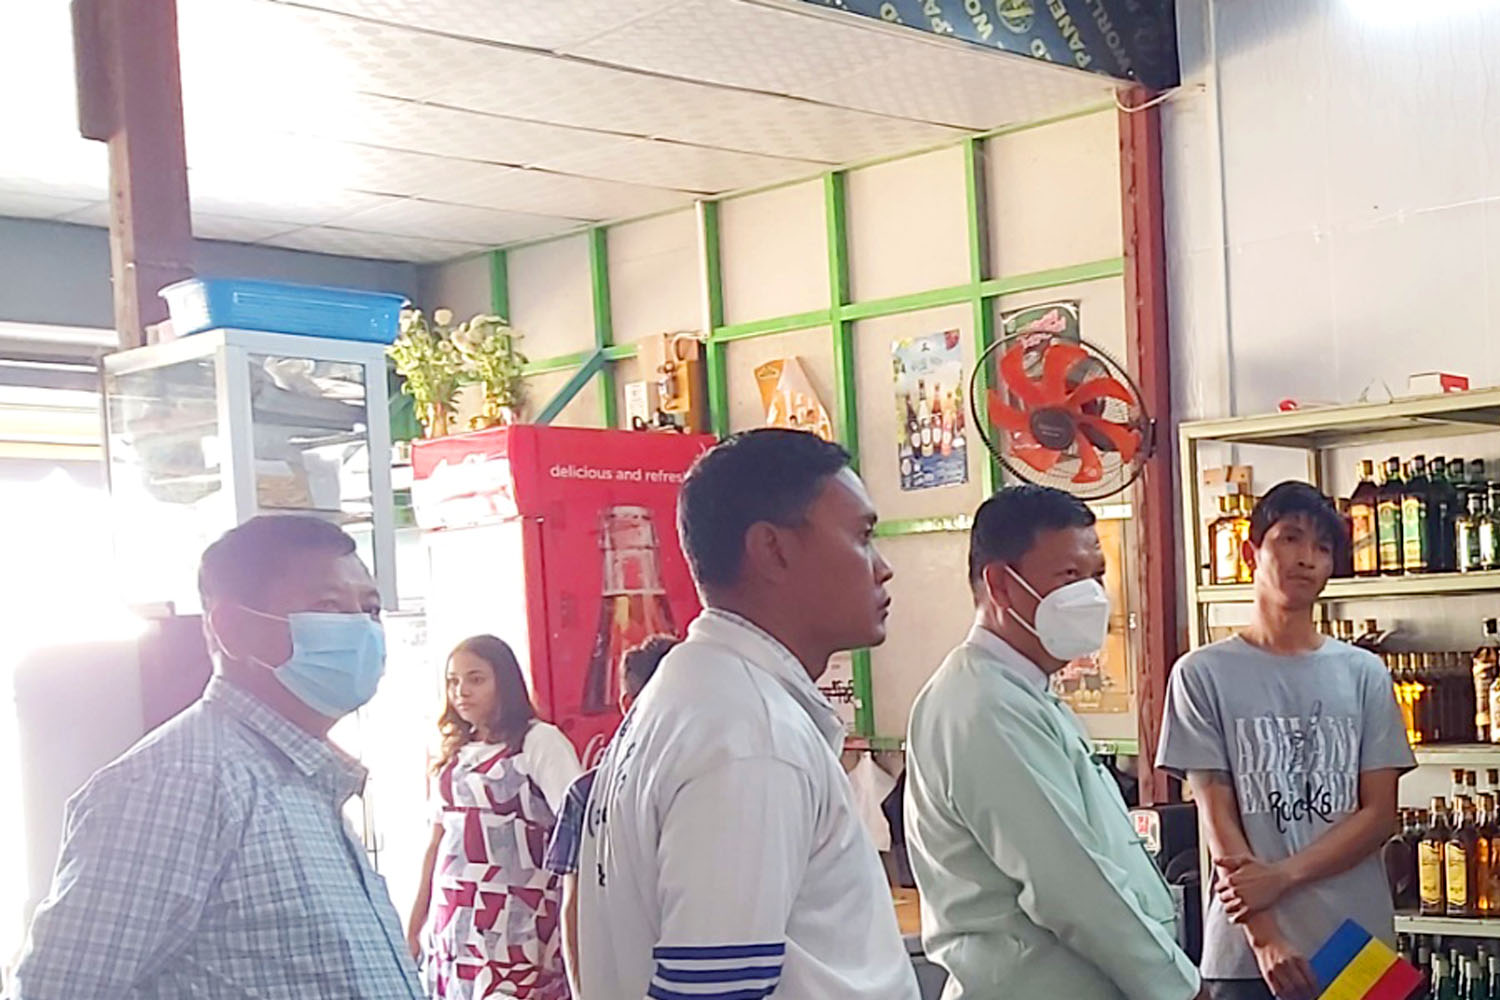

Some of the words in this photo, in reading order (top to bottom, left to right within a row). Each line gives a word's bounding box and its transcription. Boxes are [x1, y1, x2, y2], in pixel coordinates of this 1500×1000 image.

[1046, 0, 1092, 68] PANE
[1086, 0, 1132, 73] WORL
[550, 465, 613, 480] delicious
[616, 468, 642, 480] and
[645, 470, 685, 483] refres
